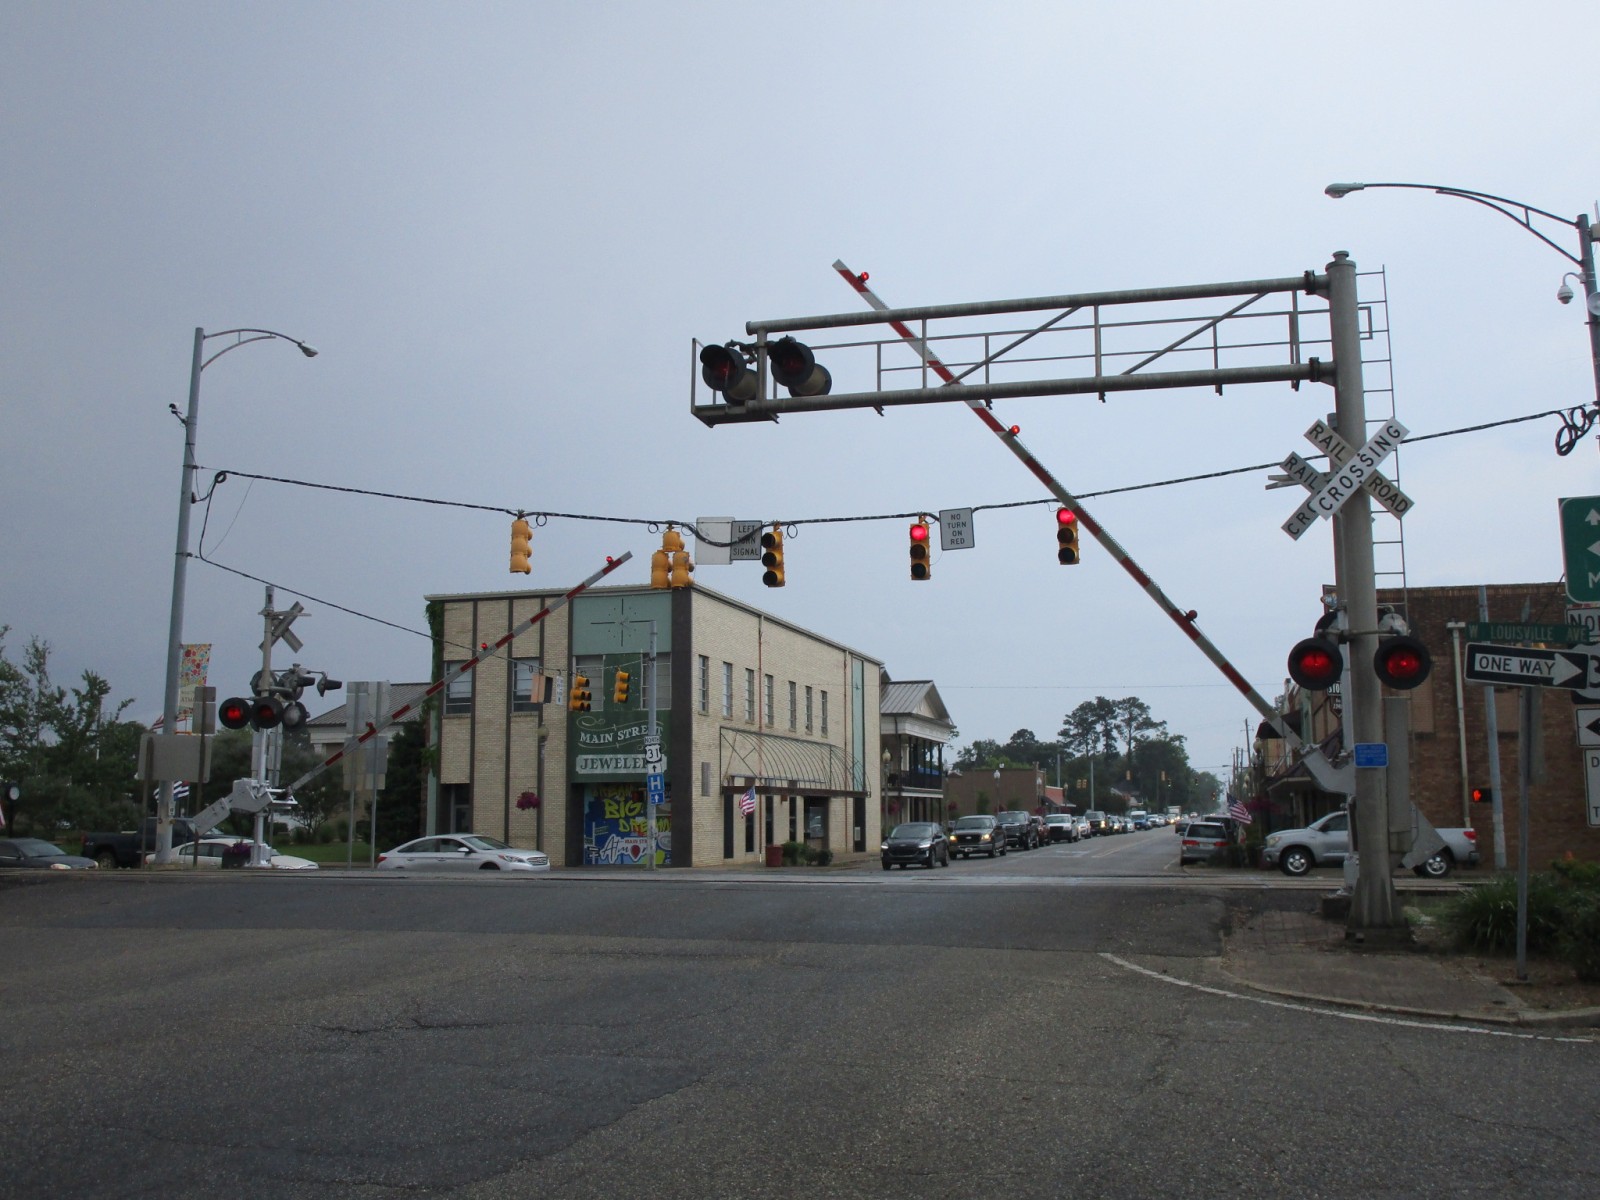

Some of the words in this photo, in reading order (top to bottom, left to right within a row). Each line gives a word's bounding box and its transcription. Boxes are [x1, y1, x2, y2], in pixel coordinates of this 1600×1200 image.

[1309, 424, 1346, 462] RAIL
[1285, 457, 1318, 490] RAIL
[1318, 425, 1401, 511] CROSSING
[1368, 476, 1408, 513] ROAD
[738, 525, 755, 533] LEFT
[947, 521, 967, 529] TURN
[732, 547, 759, 556] SIGNAL
[1469, 624, 1479, 639] W
[1490, 624, 1554, 640] LOUISVILLE
[1567, 625, 1586, 640] AVE
[1478, 655, 1512, 672] ONE
[1519, 659, 1556, 676] WAY
[580, 731, 614, 744] MAIN
[617, 724, 663, 741] STRET
[647, 748, 660, 759] 31
[650, 776, 662, 790] H
[604, 798, 642, 819] BIG
